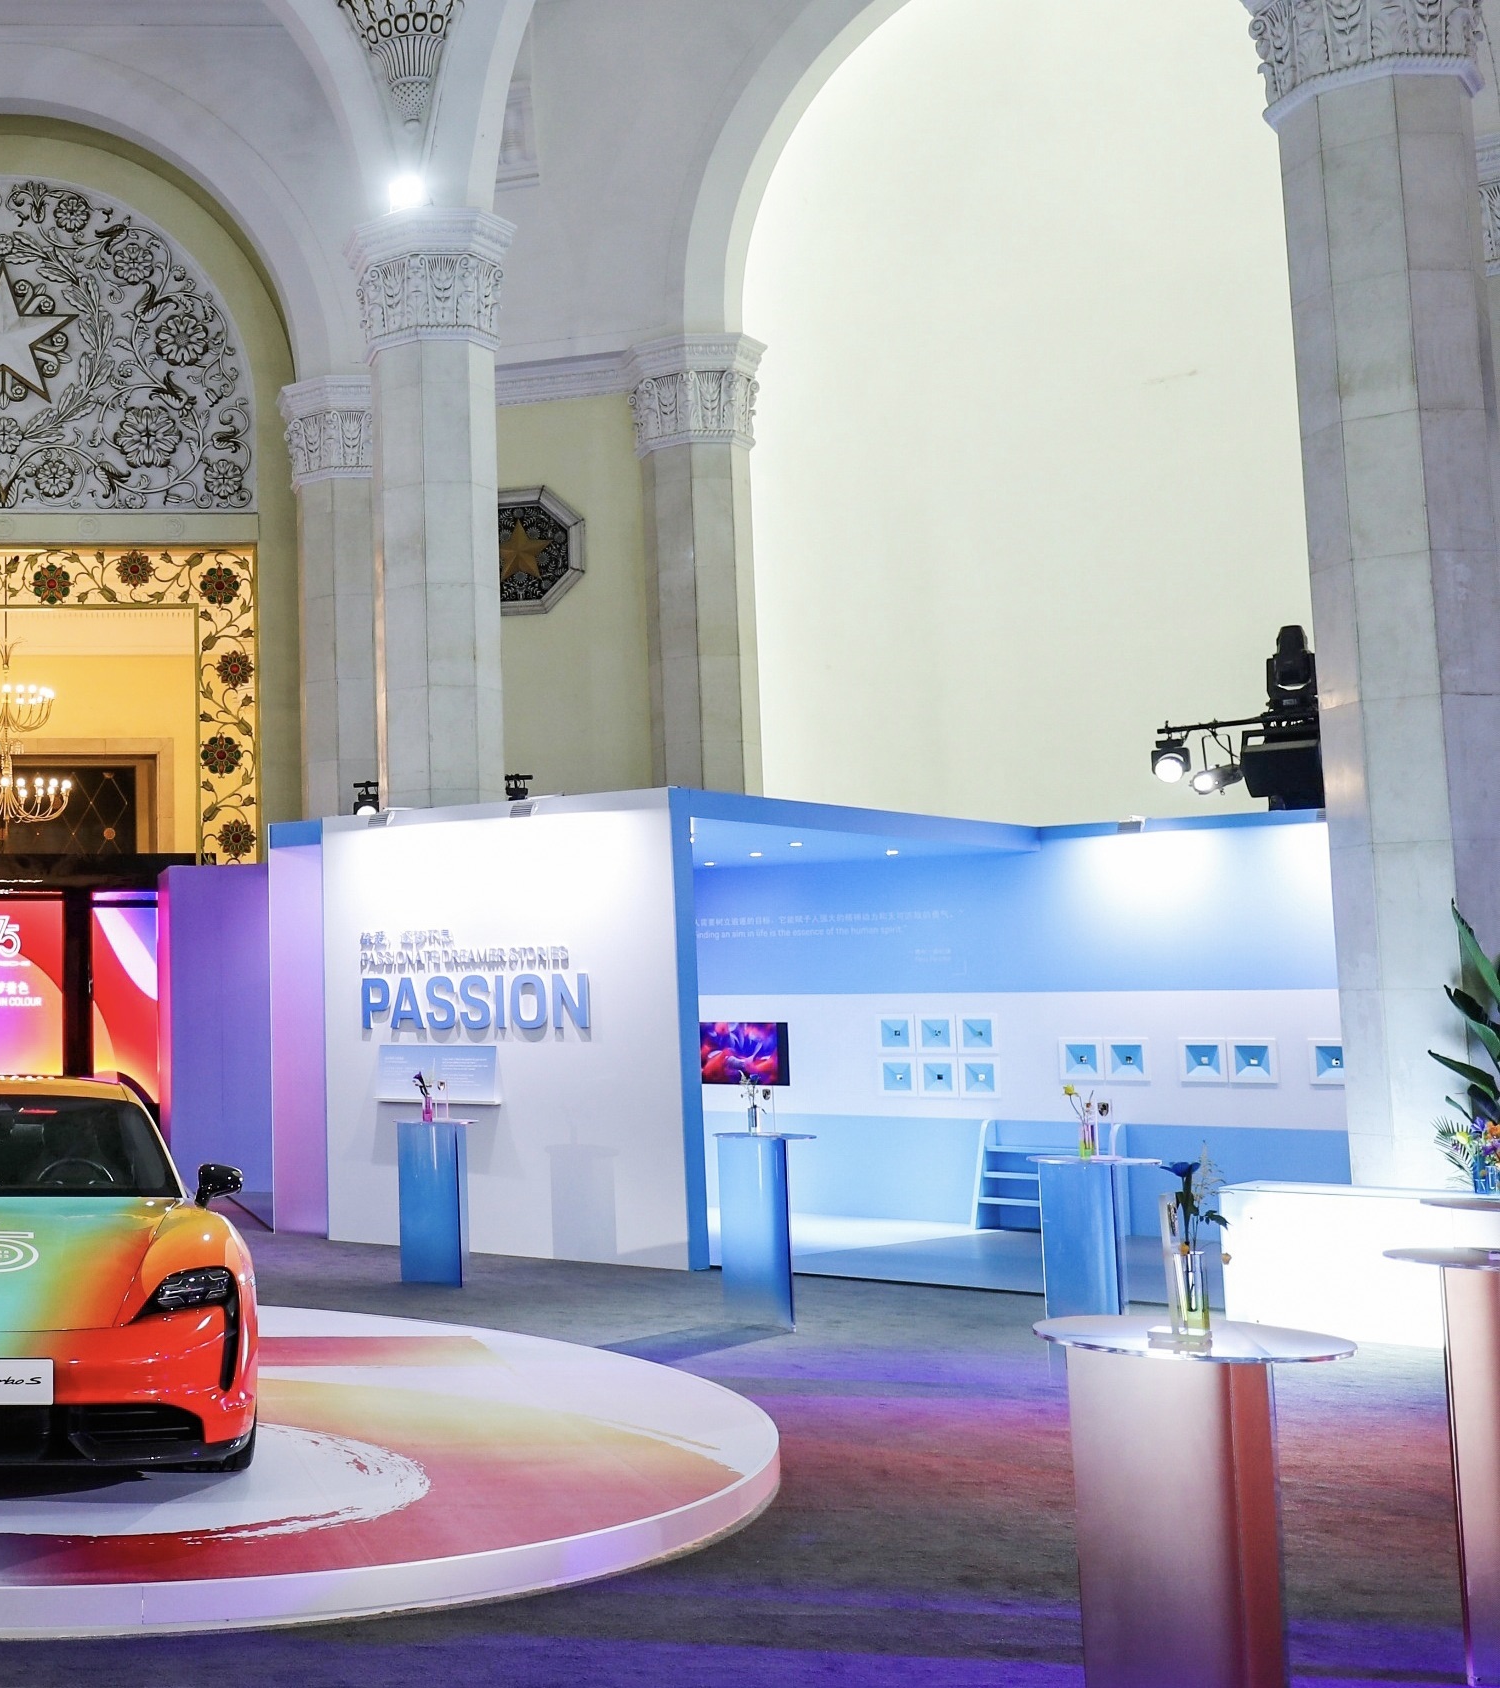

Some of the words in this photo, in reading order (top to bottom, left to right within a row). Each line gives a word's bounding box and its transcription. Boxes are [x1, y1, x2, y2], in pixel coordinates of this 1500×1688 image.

[360, 949, 440, 965] PASSIONATE
[442, 948, 506, 963] DREAMER
[509, 945, 569, 961] STORIES
[0, 997, 8, 1006] IN
[8, 997, 42, 1006] COLOUR
[361, 973, 590, 1030] PASSION
[25, 1376, 42, 1385] S
